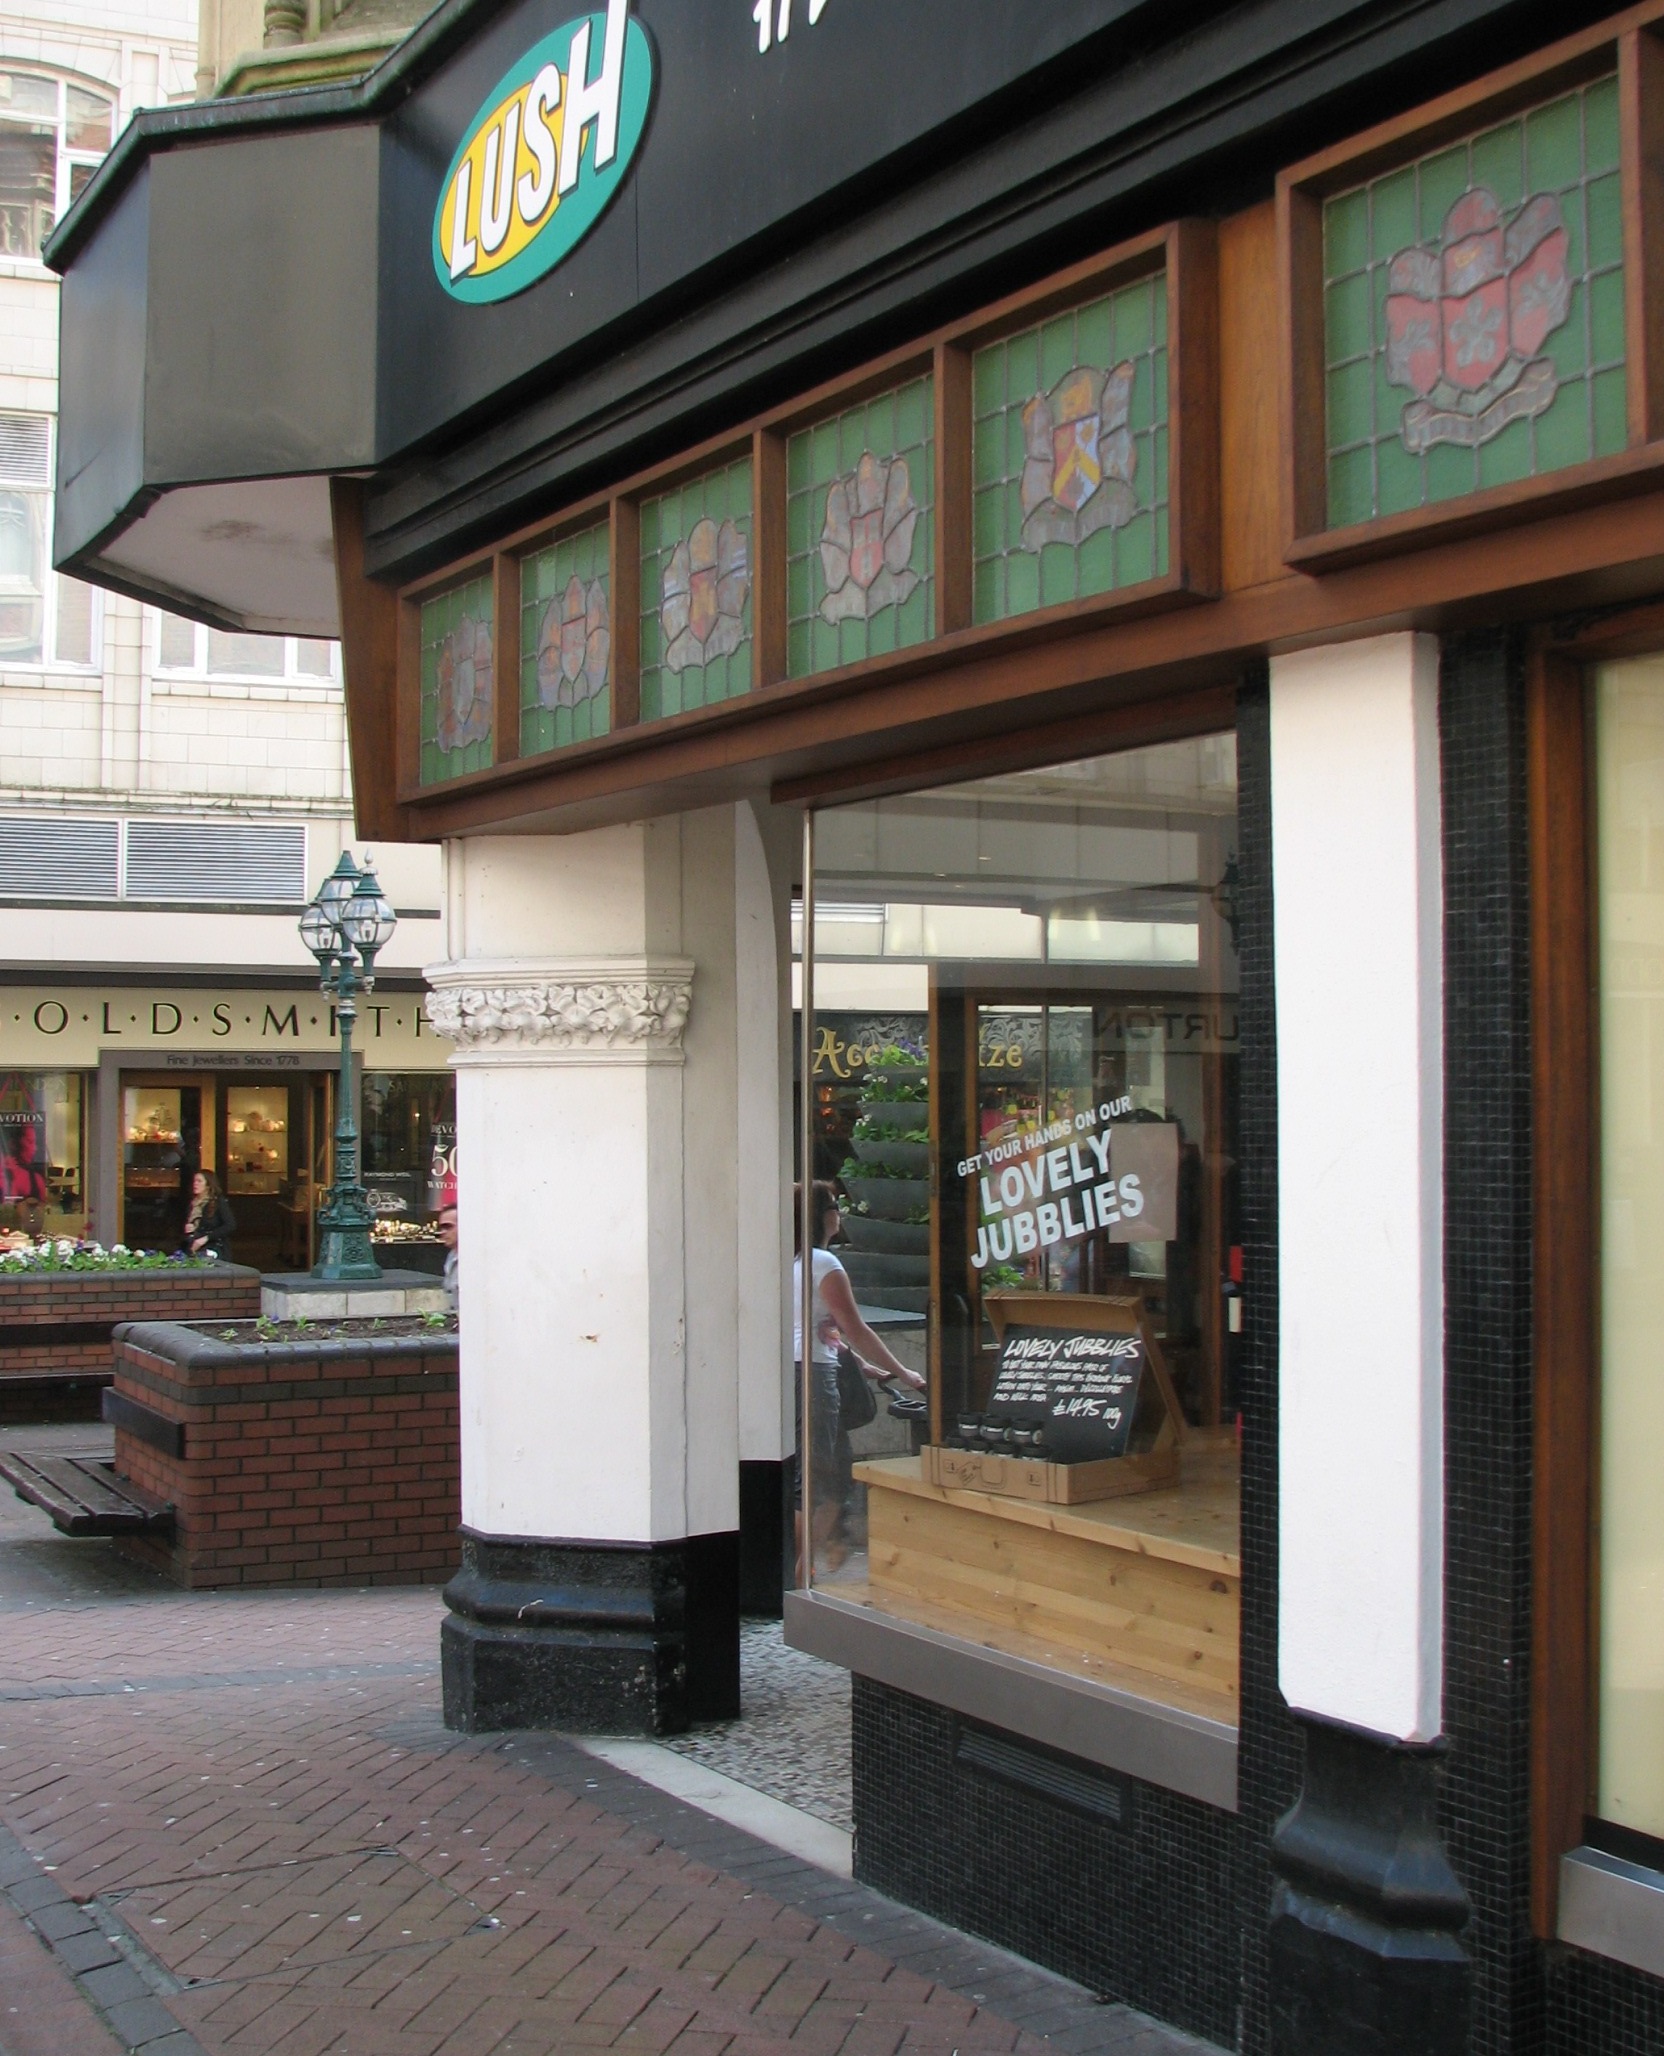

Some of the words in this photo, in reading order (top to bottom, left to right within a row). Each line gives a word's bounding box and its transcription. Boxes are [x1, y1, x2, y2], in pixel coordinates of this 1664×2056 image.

[450, 0, 631, 284] LUSH
[167, 1054, 189, 1066] Fine
[192, 1054, 239, 1067] Jewellers
[244, 1055, 273, 1066] Since
[957, 1153, 983, 1178] GET
[984, 1138, 1023, 1166] YOUR
[1024, 1118, 1073, 1151] HANDS
[1074, 1108, 1097, 1131] ON
[1099, 1094, 1133, 1121] OUR
[980, 1128, 1113, 1217] LOVELY
[970, 1173, 1145, 1269] JUBBLIES
[1003, 1337, 1065, 1360] LOVELY
[1063, 1335, 1142, 1358] JUBBLIES
